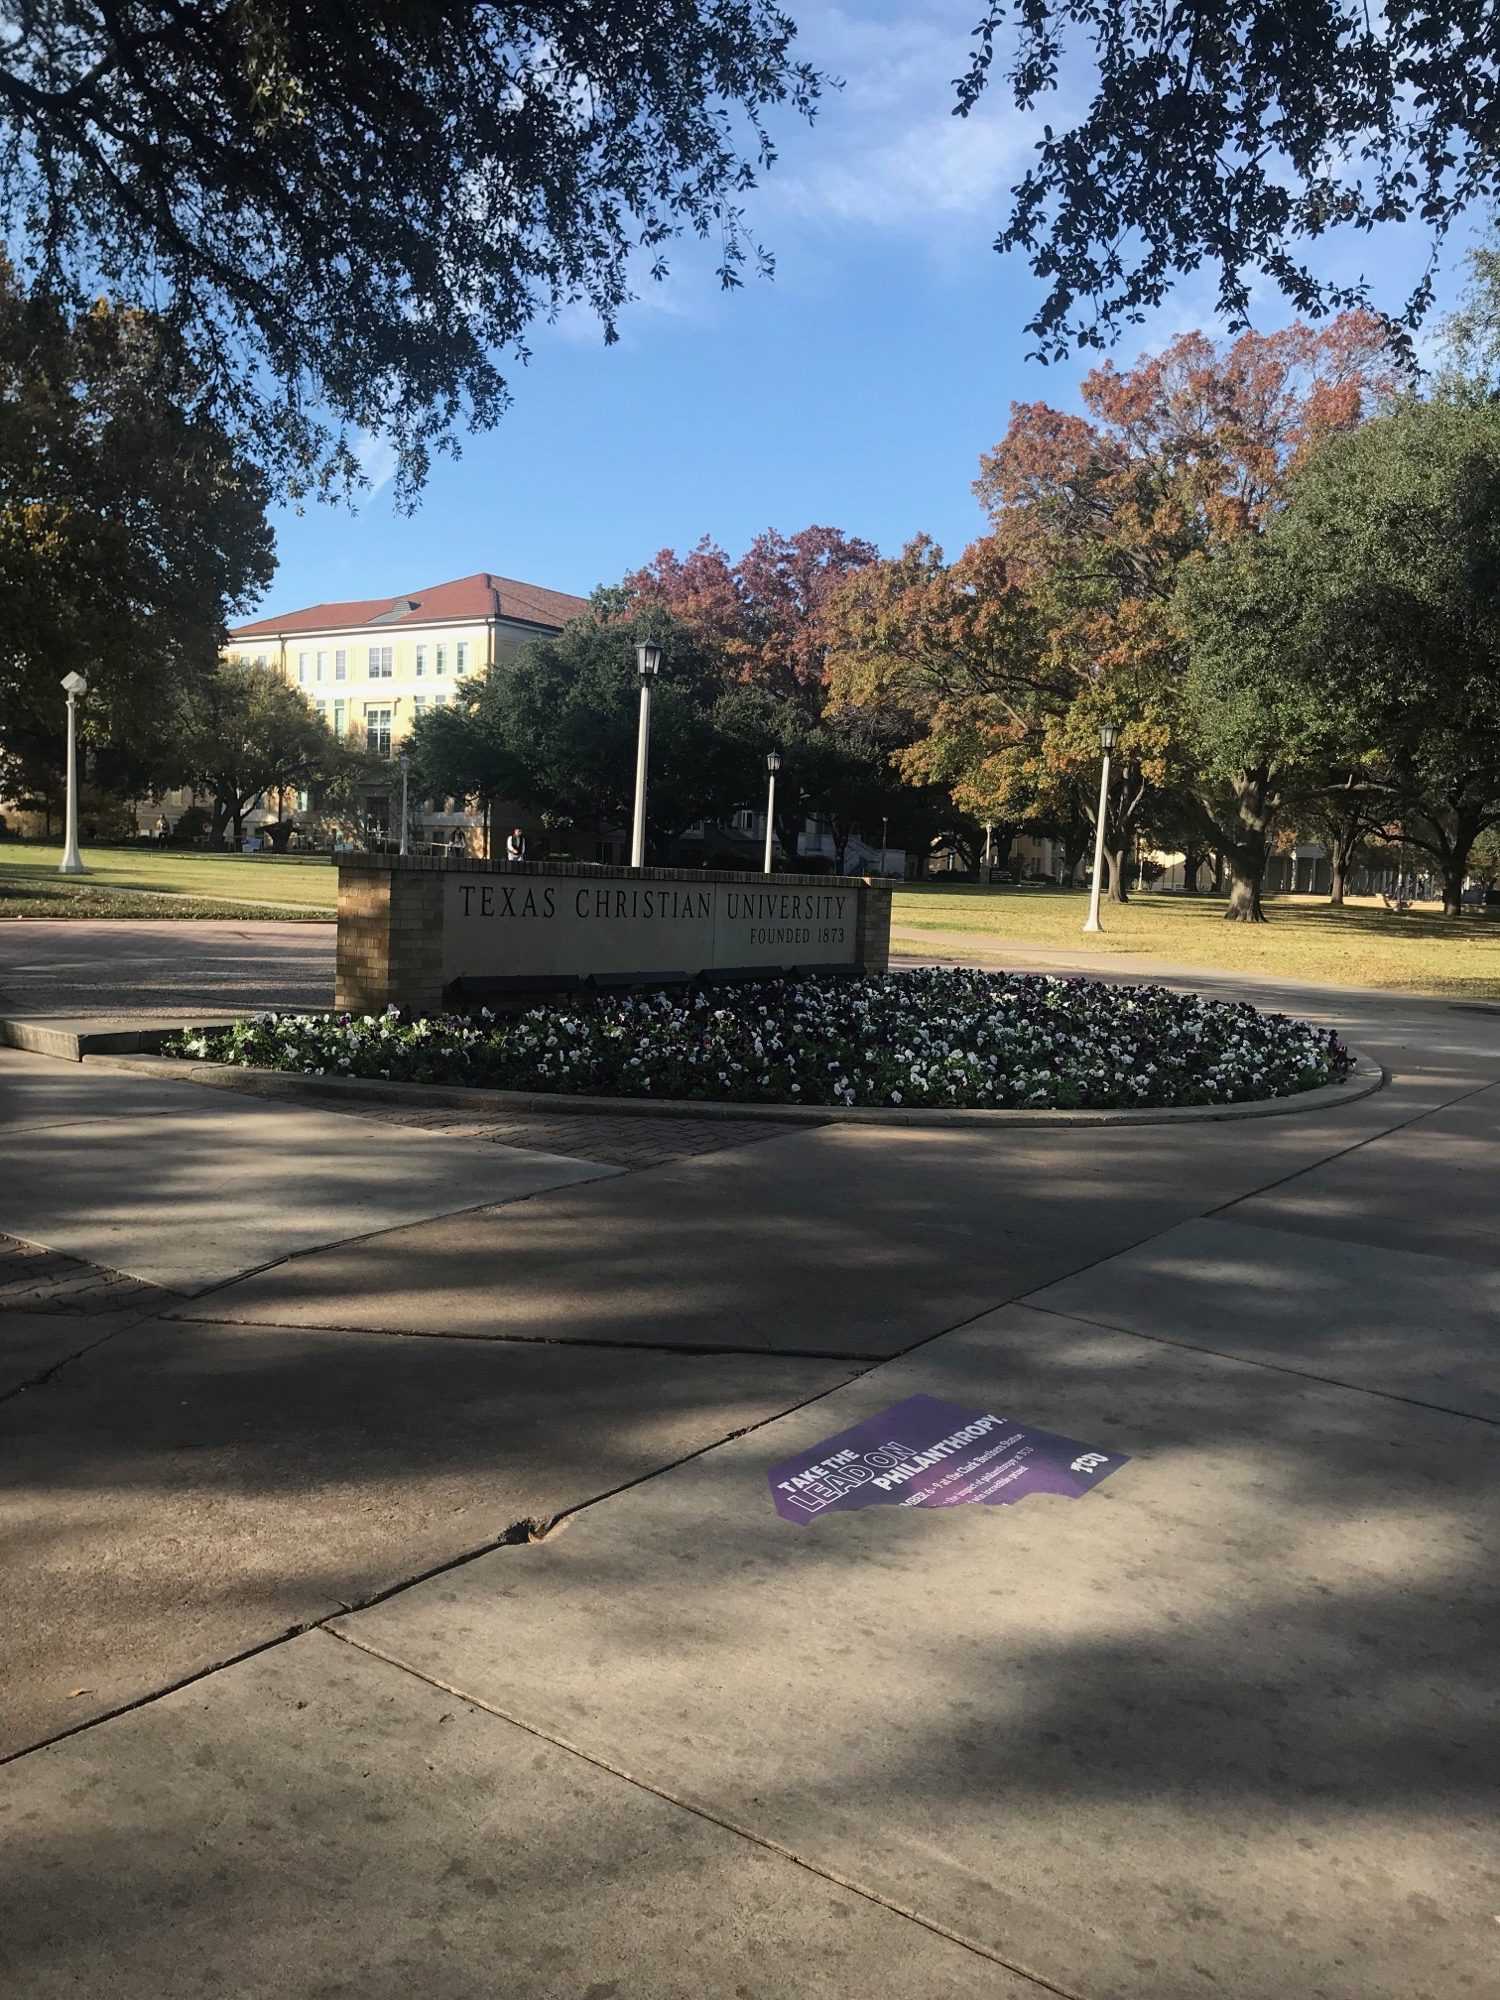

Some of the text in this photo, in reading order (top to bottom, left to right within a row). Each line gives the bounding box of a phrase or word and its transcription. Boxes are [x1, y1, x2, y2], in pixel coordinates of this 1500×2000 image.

[459, 885, 848, 920] TEXAS CHRISTIAN UNIVERSITY
[749, 926, 846, 945] FOUNDED 1873
[777, 1449, 860, 1493] TAKE THE
[787, 1440, 918, 1513] LEAD ON
[1071, 1453, 1109, 1474] TCU
